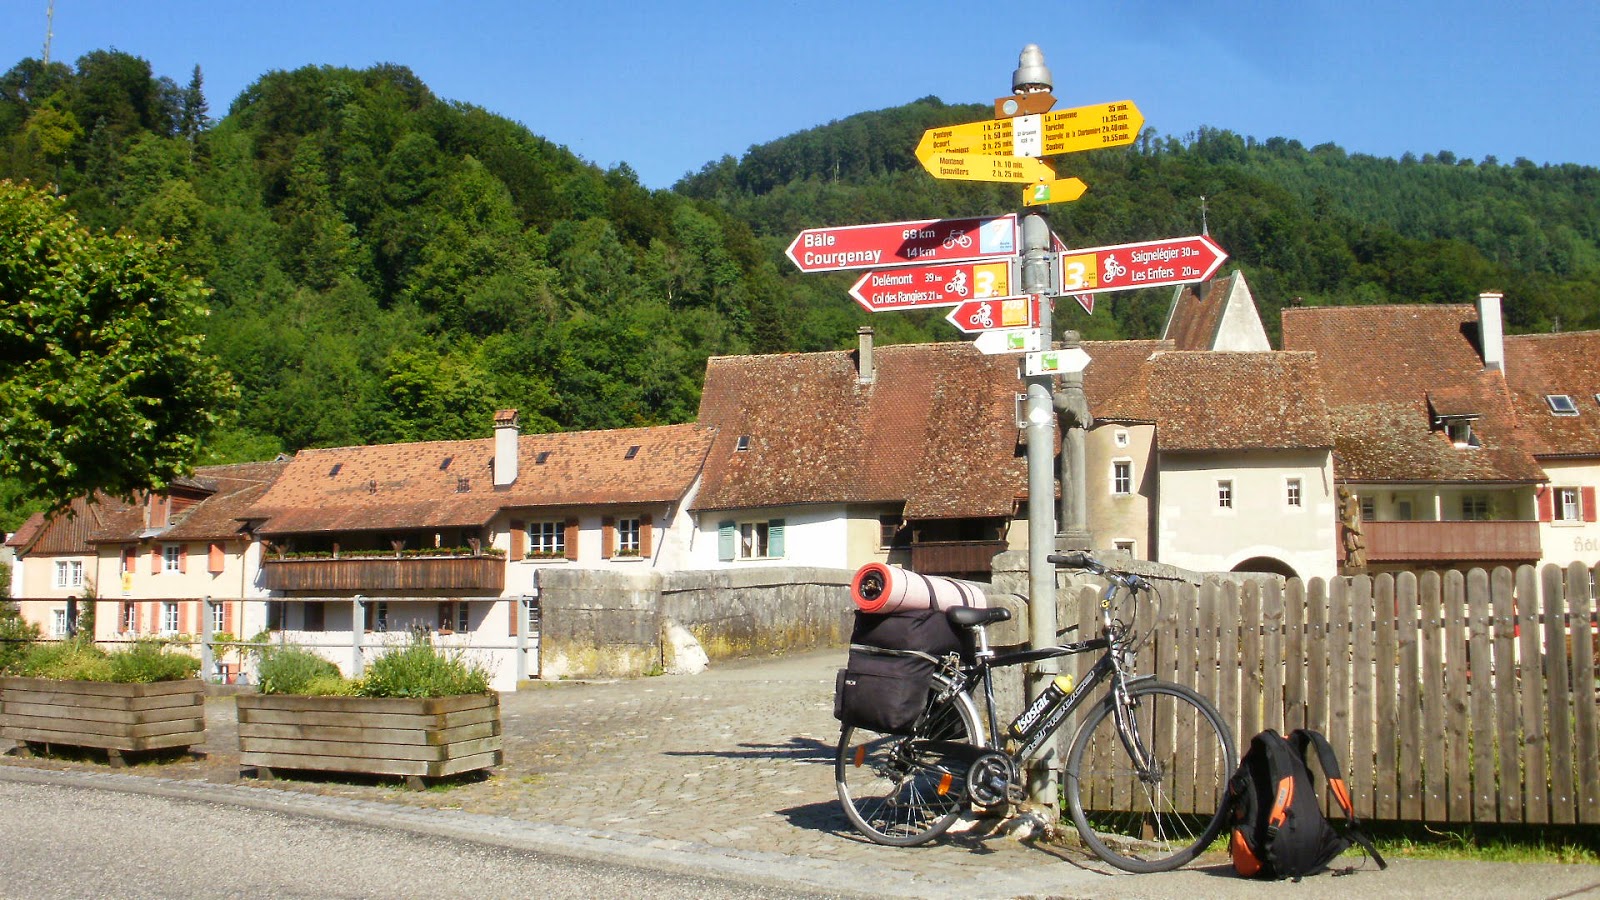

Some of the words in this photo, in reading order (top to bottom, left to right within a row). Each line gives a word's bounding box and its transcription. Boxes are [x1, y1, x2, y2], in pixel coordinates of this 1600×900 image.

[1035, 185, 1044, 198] 2
[804, 233, 835, 248] Bâle
[920, 229, 935, 239] km
[804, 250, 882, 266] Courgenay
[907, 247, 917, 257] 14
[920, 247, 936, 256] km
[1131, 248, 1179, 265] Saignelégier
[1182, 247, 1191, 257] 30
[872, 274, 913, 287] Delémont
[1065, 262, 1085, 290] 3
[1131, 269, 1146, 282] Les
[1148, 268, 1174, 280] Enfers
[1182, 267, 1191, 276] 20
[975, 271, 995, 297] 3
[872, 291, 884, 304] Col
[885, 292, 897, 303] des
[898, 290, 927, 304] Rangiers
[928, 291, 935, 300] 21
